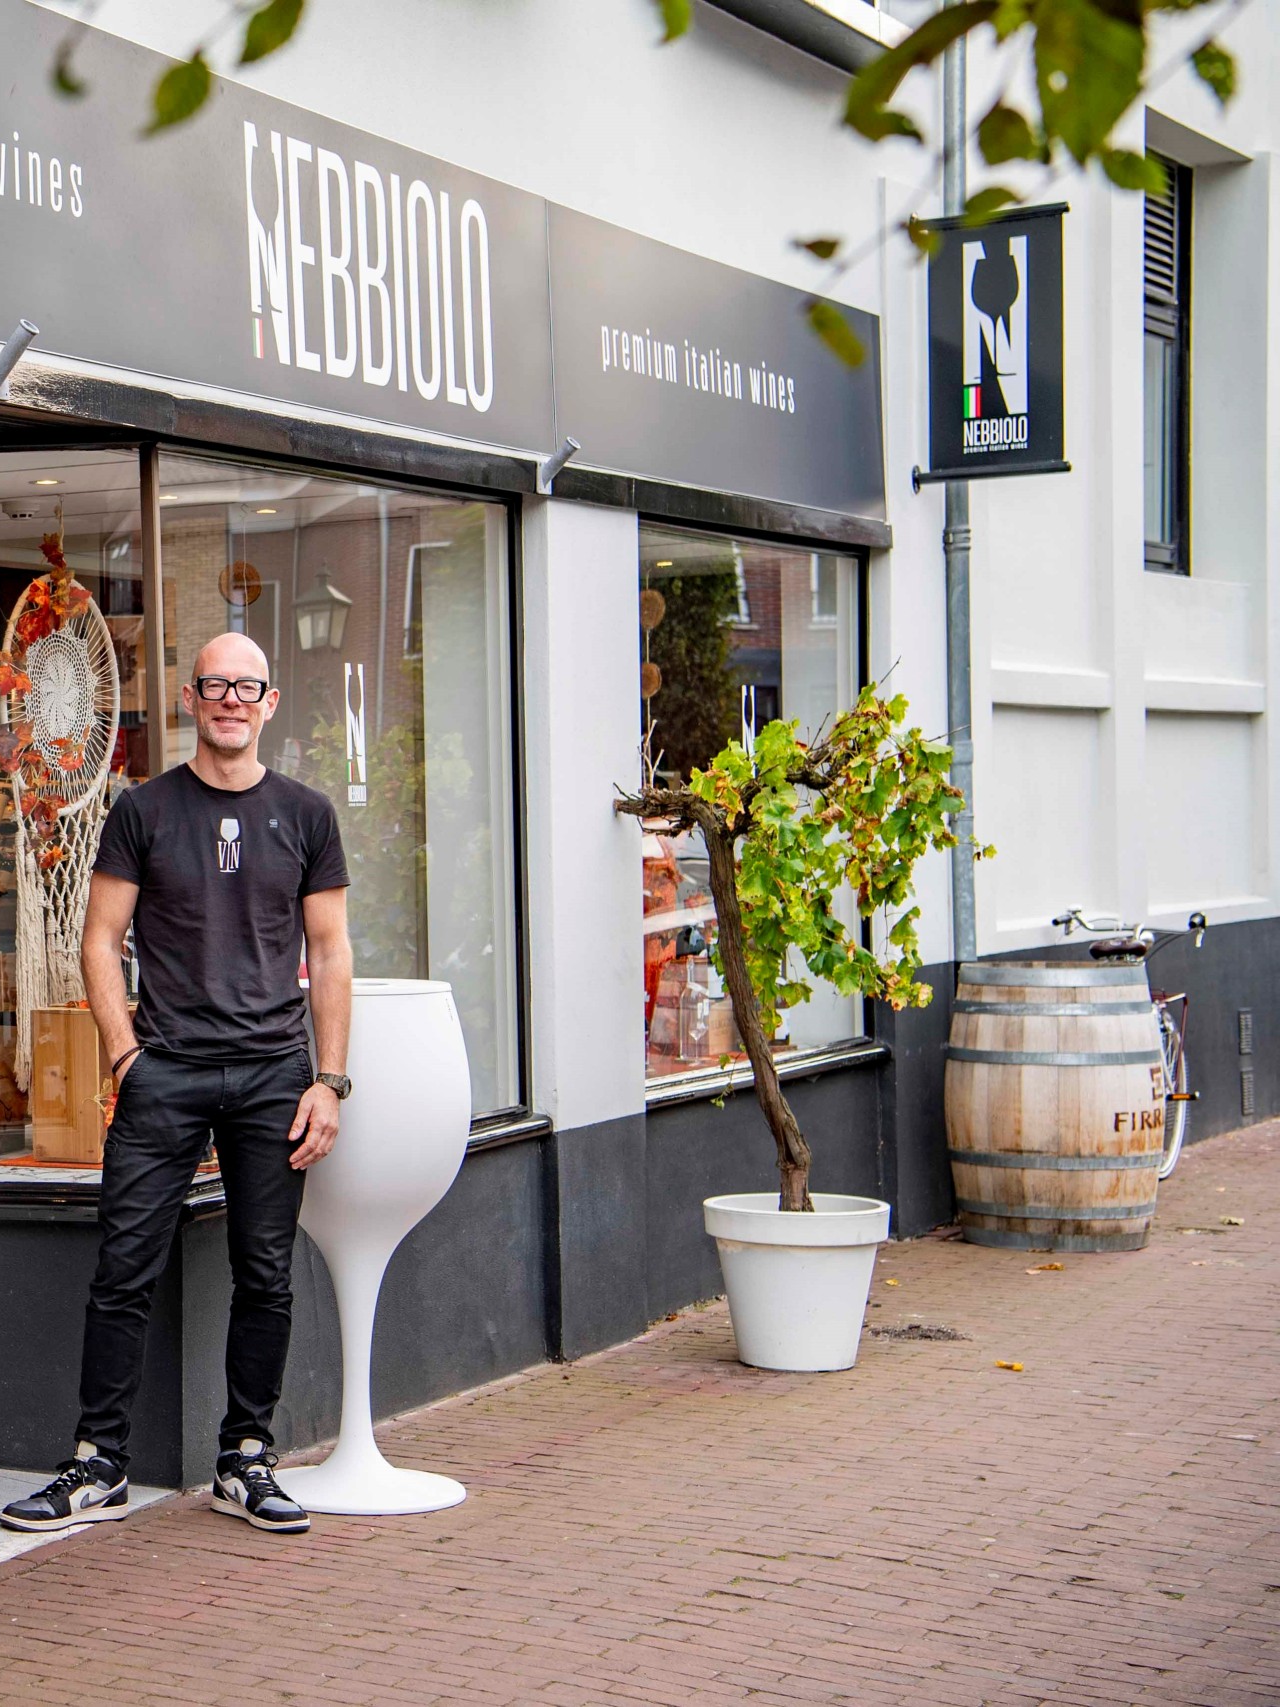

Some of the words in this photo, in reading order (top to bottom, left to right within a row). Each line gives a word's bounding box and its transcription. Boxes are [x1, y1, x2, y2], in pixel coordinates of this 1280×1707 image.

[243, 120, 494, 413] NEBBIOLO
[601, 326, 677, 385] premium
[684, 338, 741, 401] italian
[750, 360, 795, 414] wines
[963, 416, 1029, 447] NEBBIOLO
[1114, 1108, 1163, 1133] FIRR
